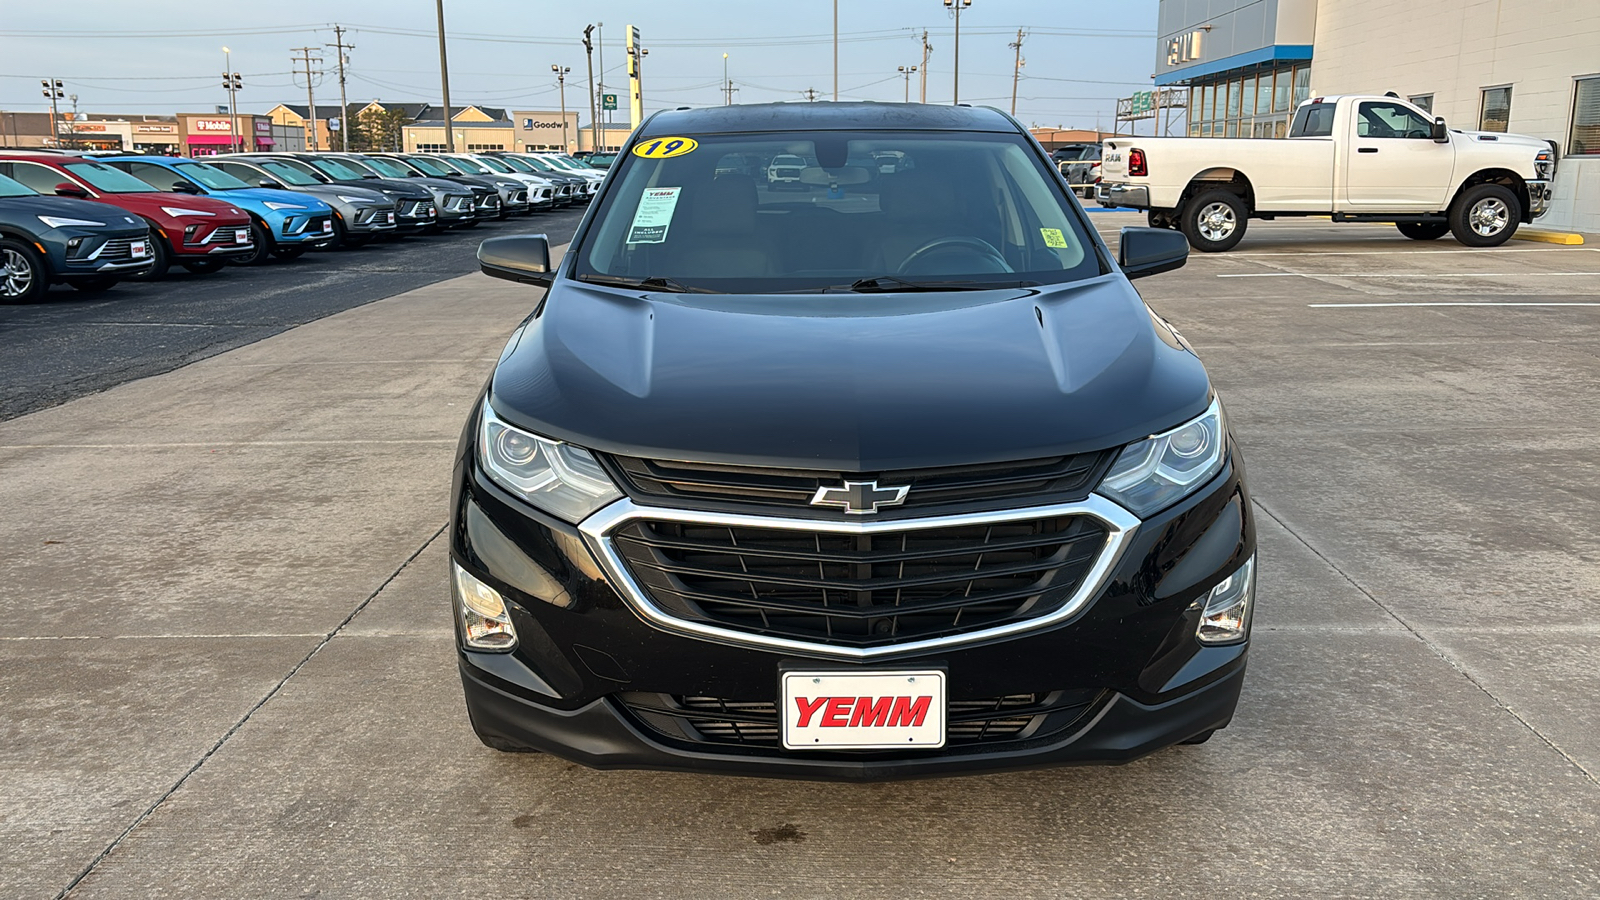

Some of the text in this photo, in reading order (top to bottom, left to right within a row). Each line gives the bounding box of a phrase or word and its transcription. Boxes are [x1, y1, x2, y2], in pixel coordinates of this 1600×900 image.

[205, 121, 230, 130] Mobile
[533, 121, 569, 129] Goodwll
[645, 140, 684, 155] 19
[1105, 153, 1121, 162] RAM
[794, 695, 933, 728] YEMM
